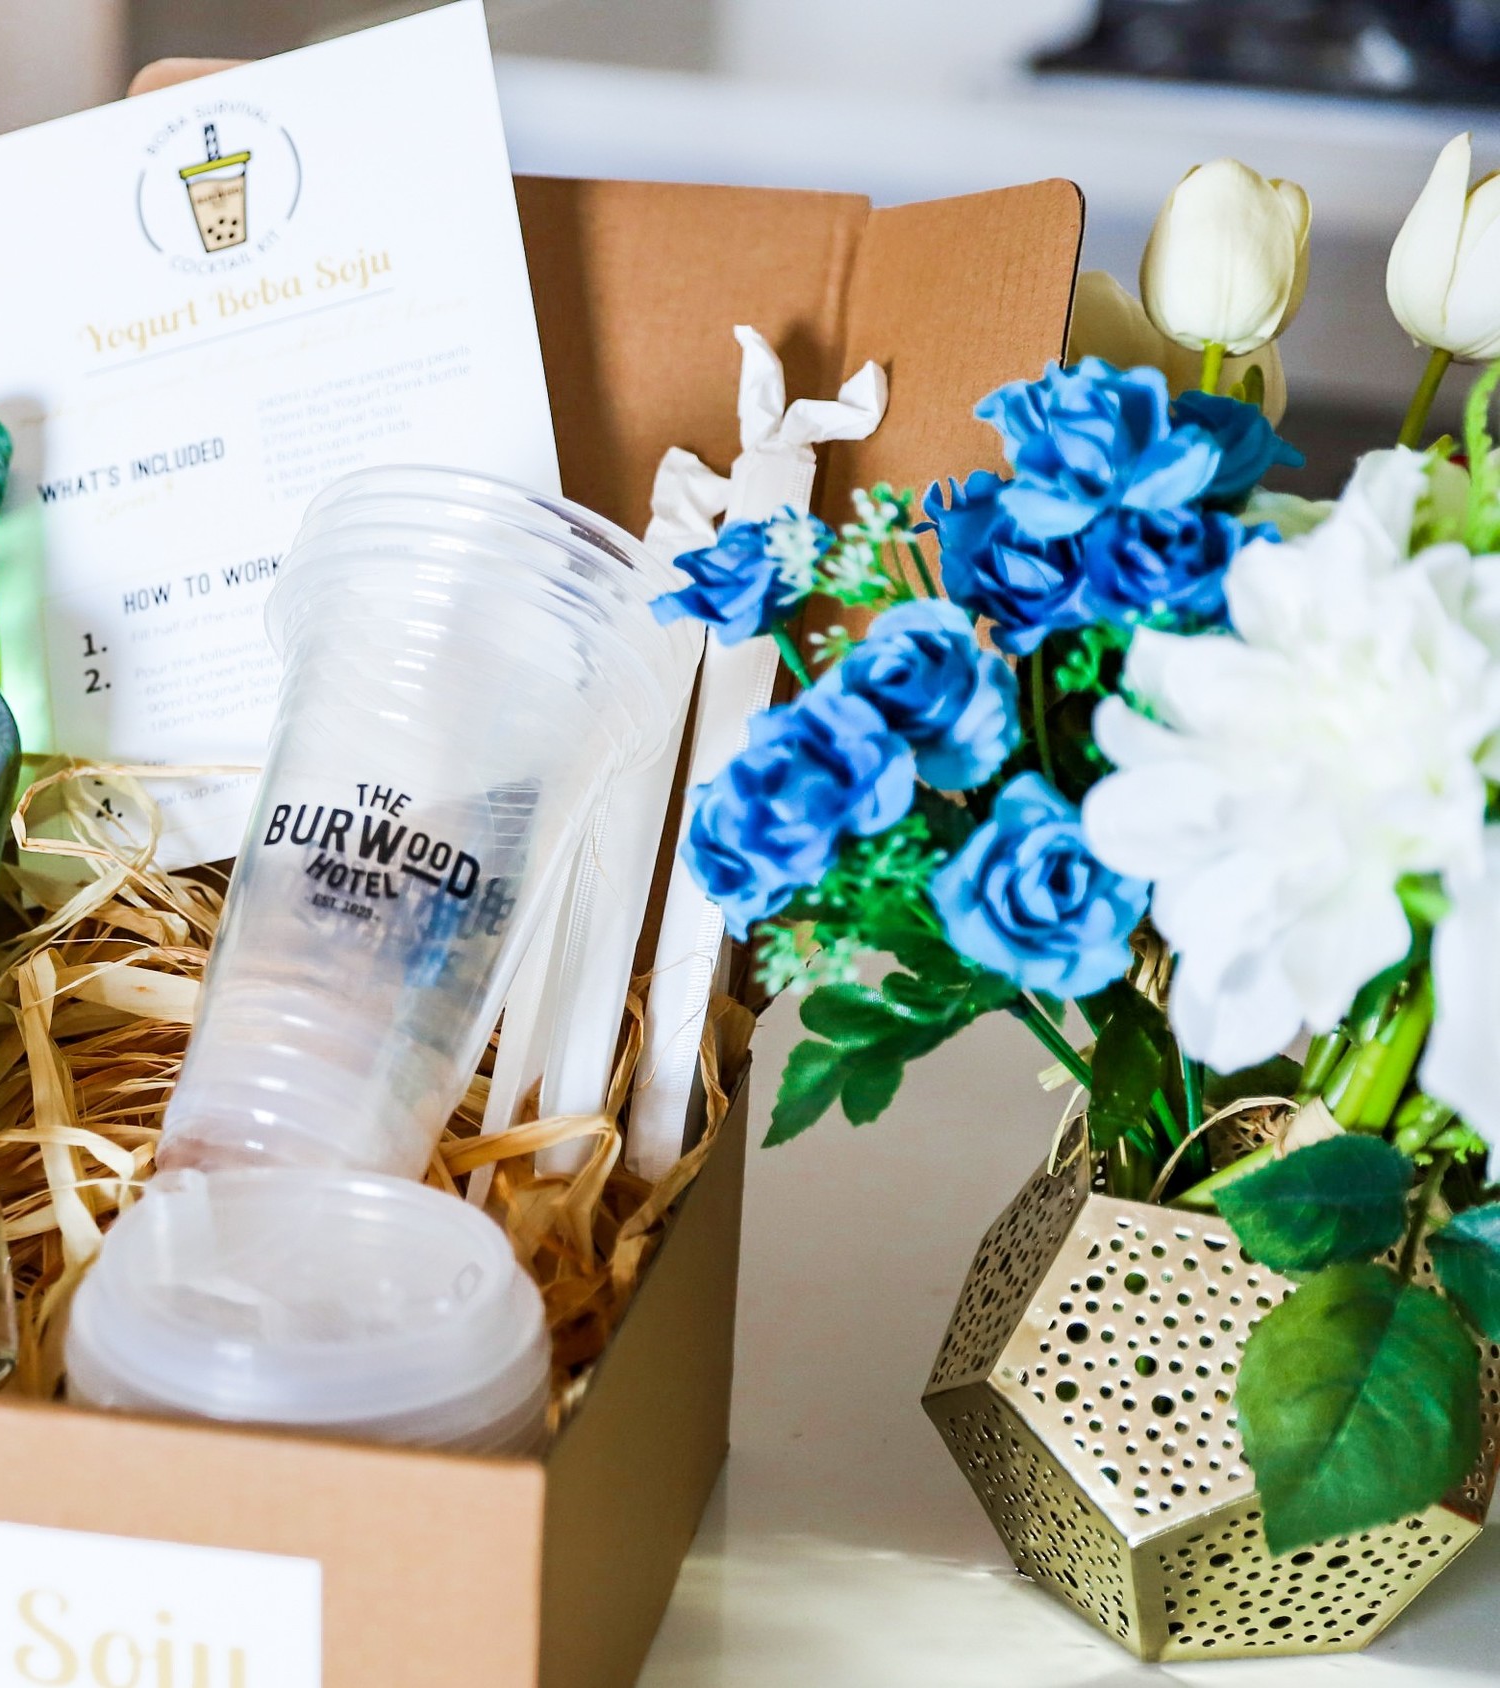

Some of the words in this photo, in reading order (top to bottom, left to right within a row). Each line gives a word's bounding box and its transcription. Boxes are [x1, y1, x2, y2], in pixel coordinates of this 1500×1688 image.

[78, 299, 200, 352] Yogurt
[208, 275, 303, 317] Boba
[314, 247, 393, 289] Soju
[37, 466, 121, 503] WHAT'S
[131, 437, 225, 481] INCLUDED
[123, 583, 171, 614] HOW
[184, 573, 210, 597] TO
[81, 631, 108, 659] 1.
[83, 668, 112, 696] 2.
[356, 783, 411, 818] THE
[263, 803, 480, 899] BURWOOD
[306, 853, 399, 899] HOTEL
